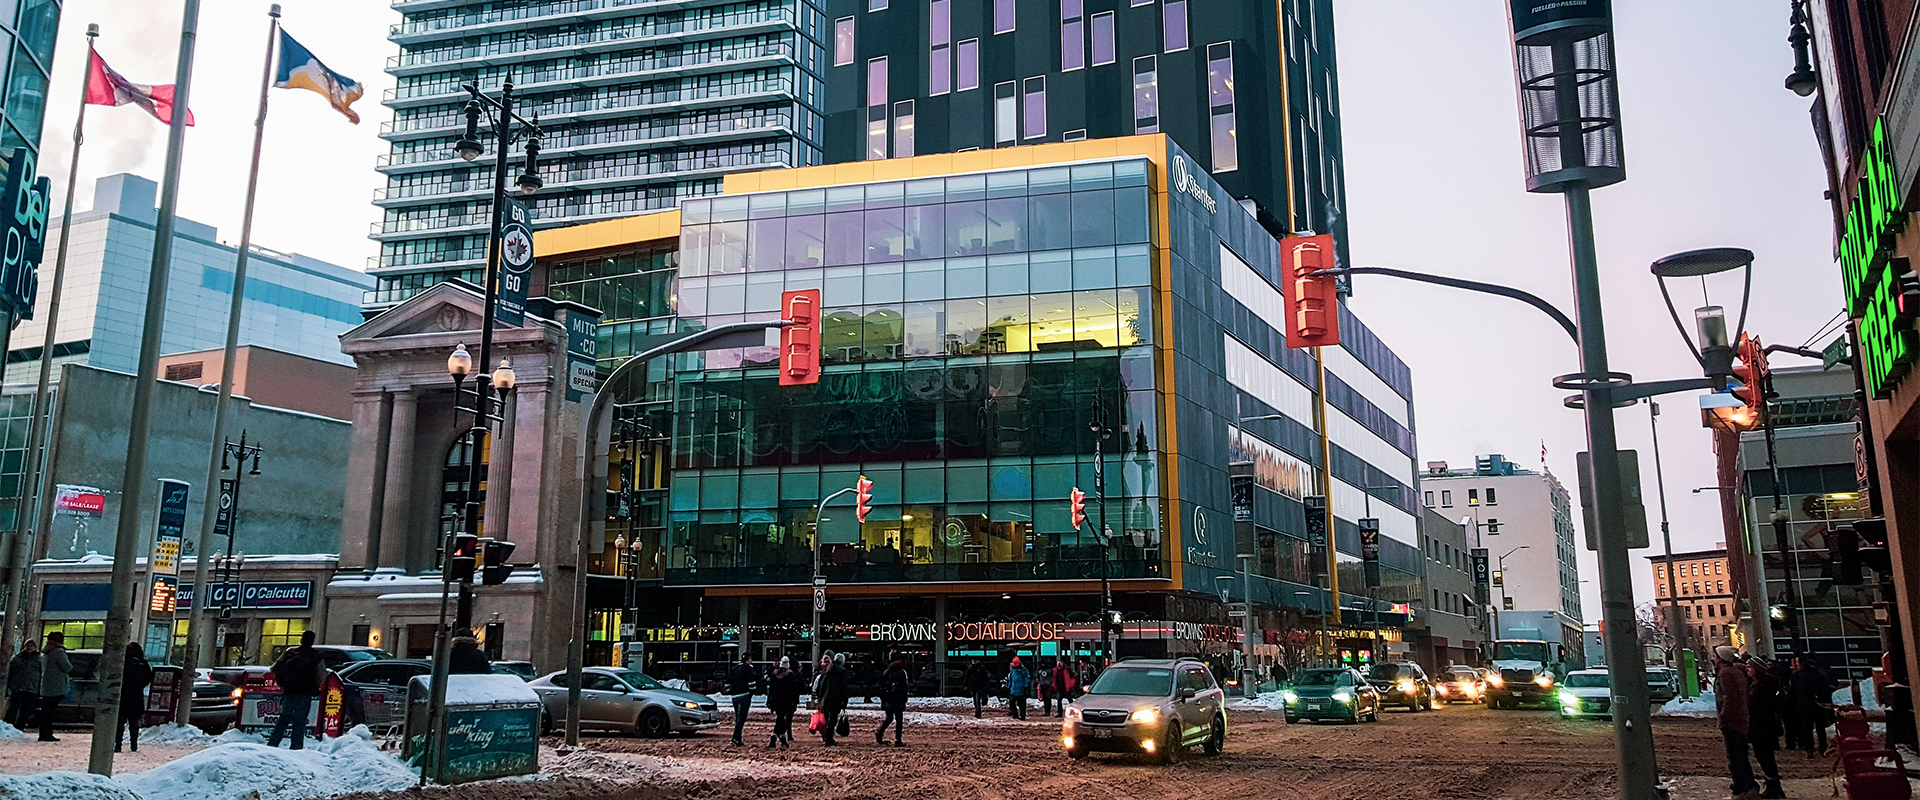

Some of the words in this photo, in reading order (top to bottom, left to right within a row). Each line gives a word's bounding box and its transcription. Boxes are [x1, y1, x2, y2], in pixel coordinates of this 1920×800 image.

[1531, 3, 1556, 14] FUELLED
[1186, 173, 1217, 215] Stantec
[511, 205, 525, 223] GO
[505, 274, 521, 292] GO
[573, 318, 596, 337] MITC
[1859, 261, 1904, 399] TREE
[69, 501, 99, 510] SALE/LEASE
[225, 588, 237, 601] C
[245, 587, 256, 599] O
[257, 586, 307, 600] Calcutta
[1176, 621, 1203, 641] BROWNS
